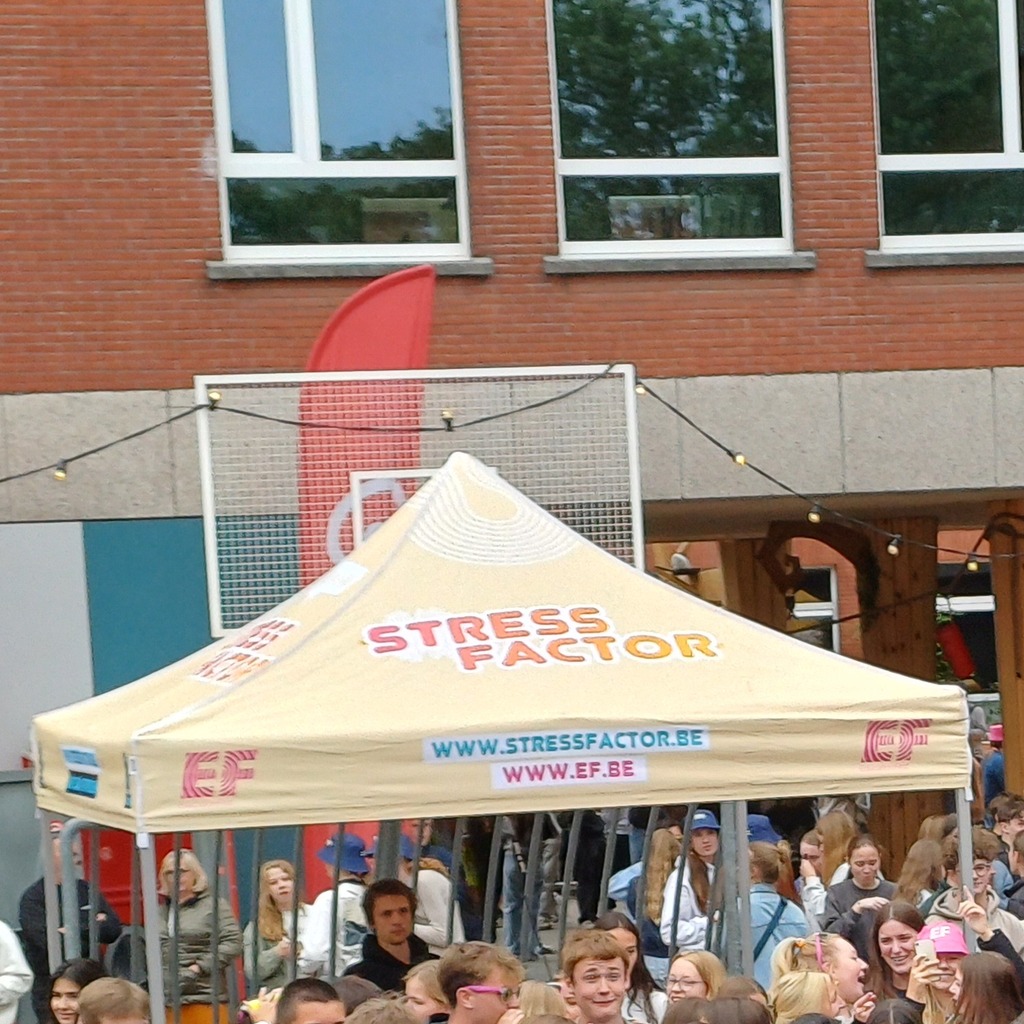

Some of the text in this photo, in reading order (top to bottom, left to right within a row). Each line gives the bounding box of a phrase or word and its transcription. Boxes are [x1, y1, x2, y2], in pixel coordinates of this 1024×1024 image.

[367, 606, 609, 654] STRESS
[456, 633, 717, 671] FACTOR
[431, 728, 704, 758] WWW.STRESSFACTOR.BE
[502, 760, 635, 783] WWW.EF.BE
[929, 926, 951, 940] EF
